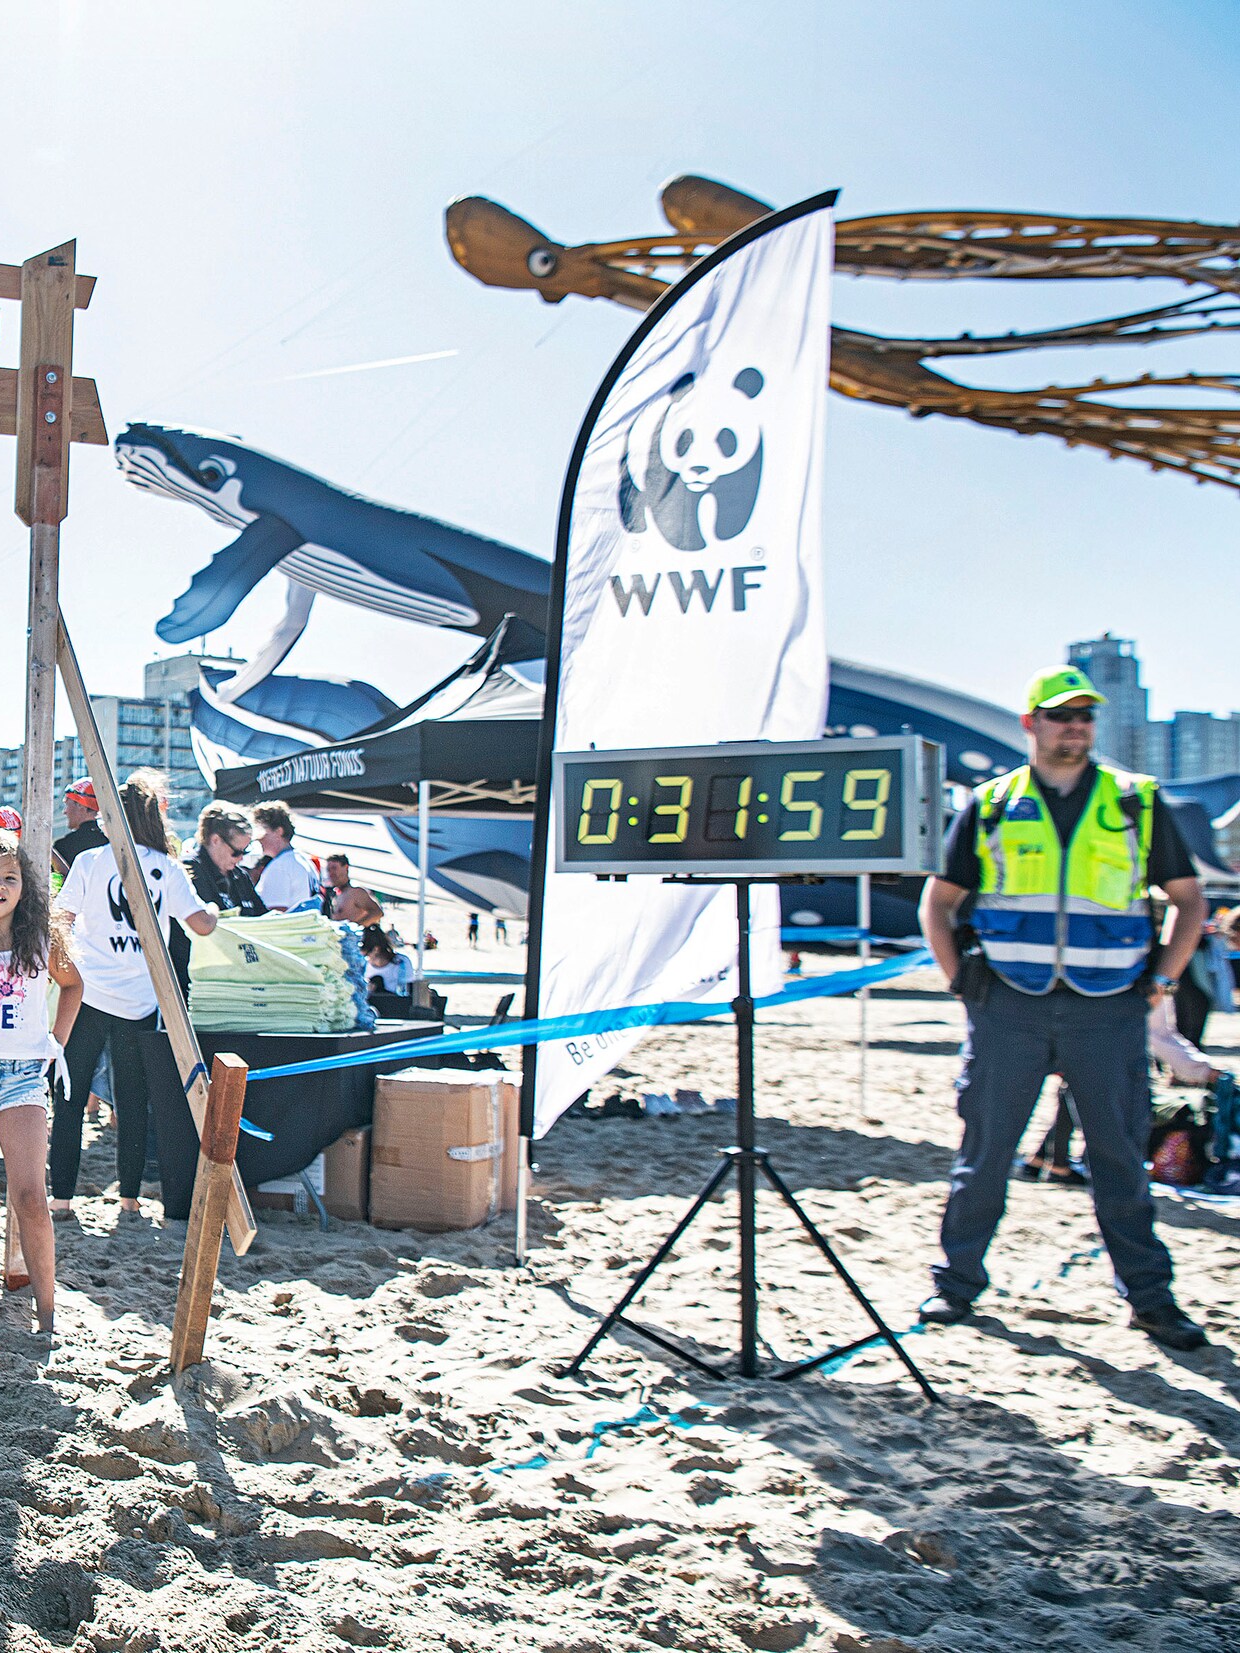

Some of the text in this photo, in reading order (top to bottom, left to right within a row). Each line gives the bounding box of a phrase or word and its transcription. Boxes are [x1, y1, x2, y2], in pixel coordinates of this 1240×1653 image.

[608, 565, 767, 618] WWF
[256, 747, 366, 793] WERELD NATUUR FONDS
[577, 768, 891, 845] 0:31:59
[109, 936, 143, 953] WW
[566, 1041, 594, 1066] Be
